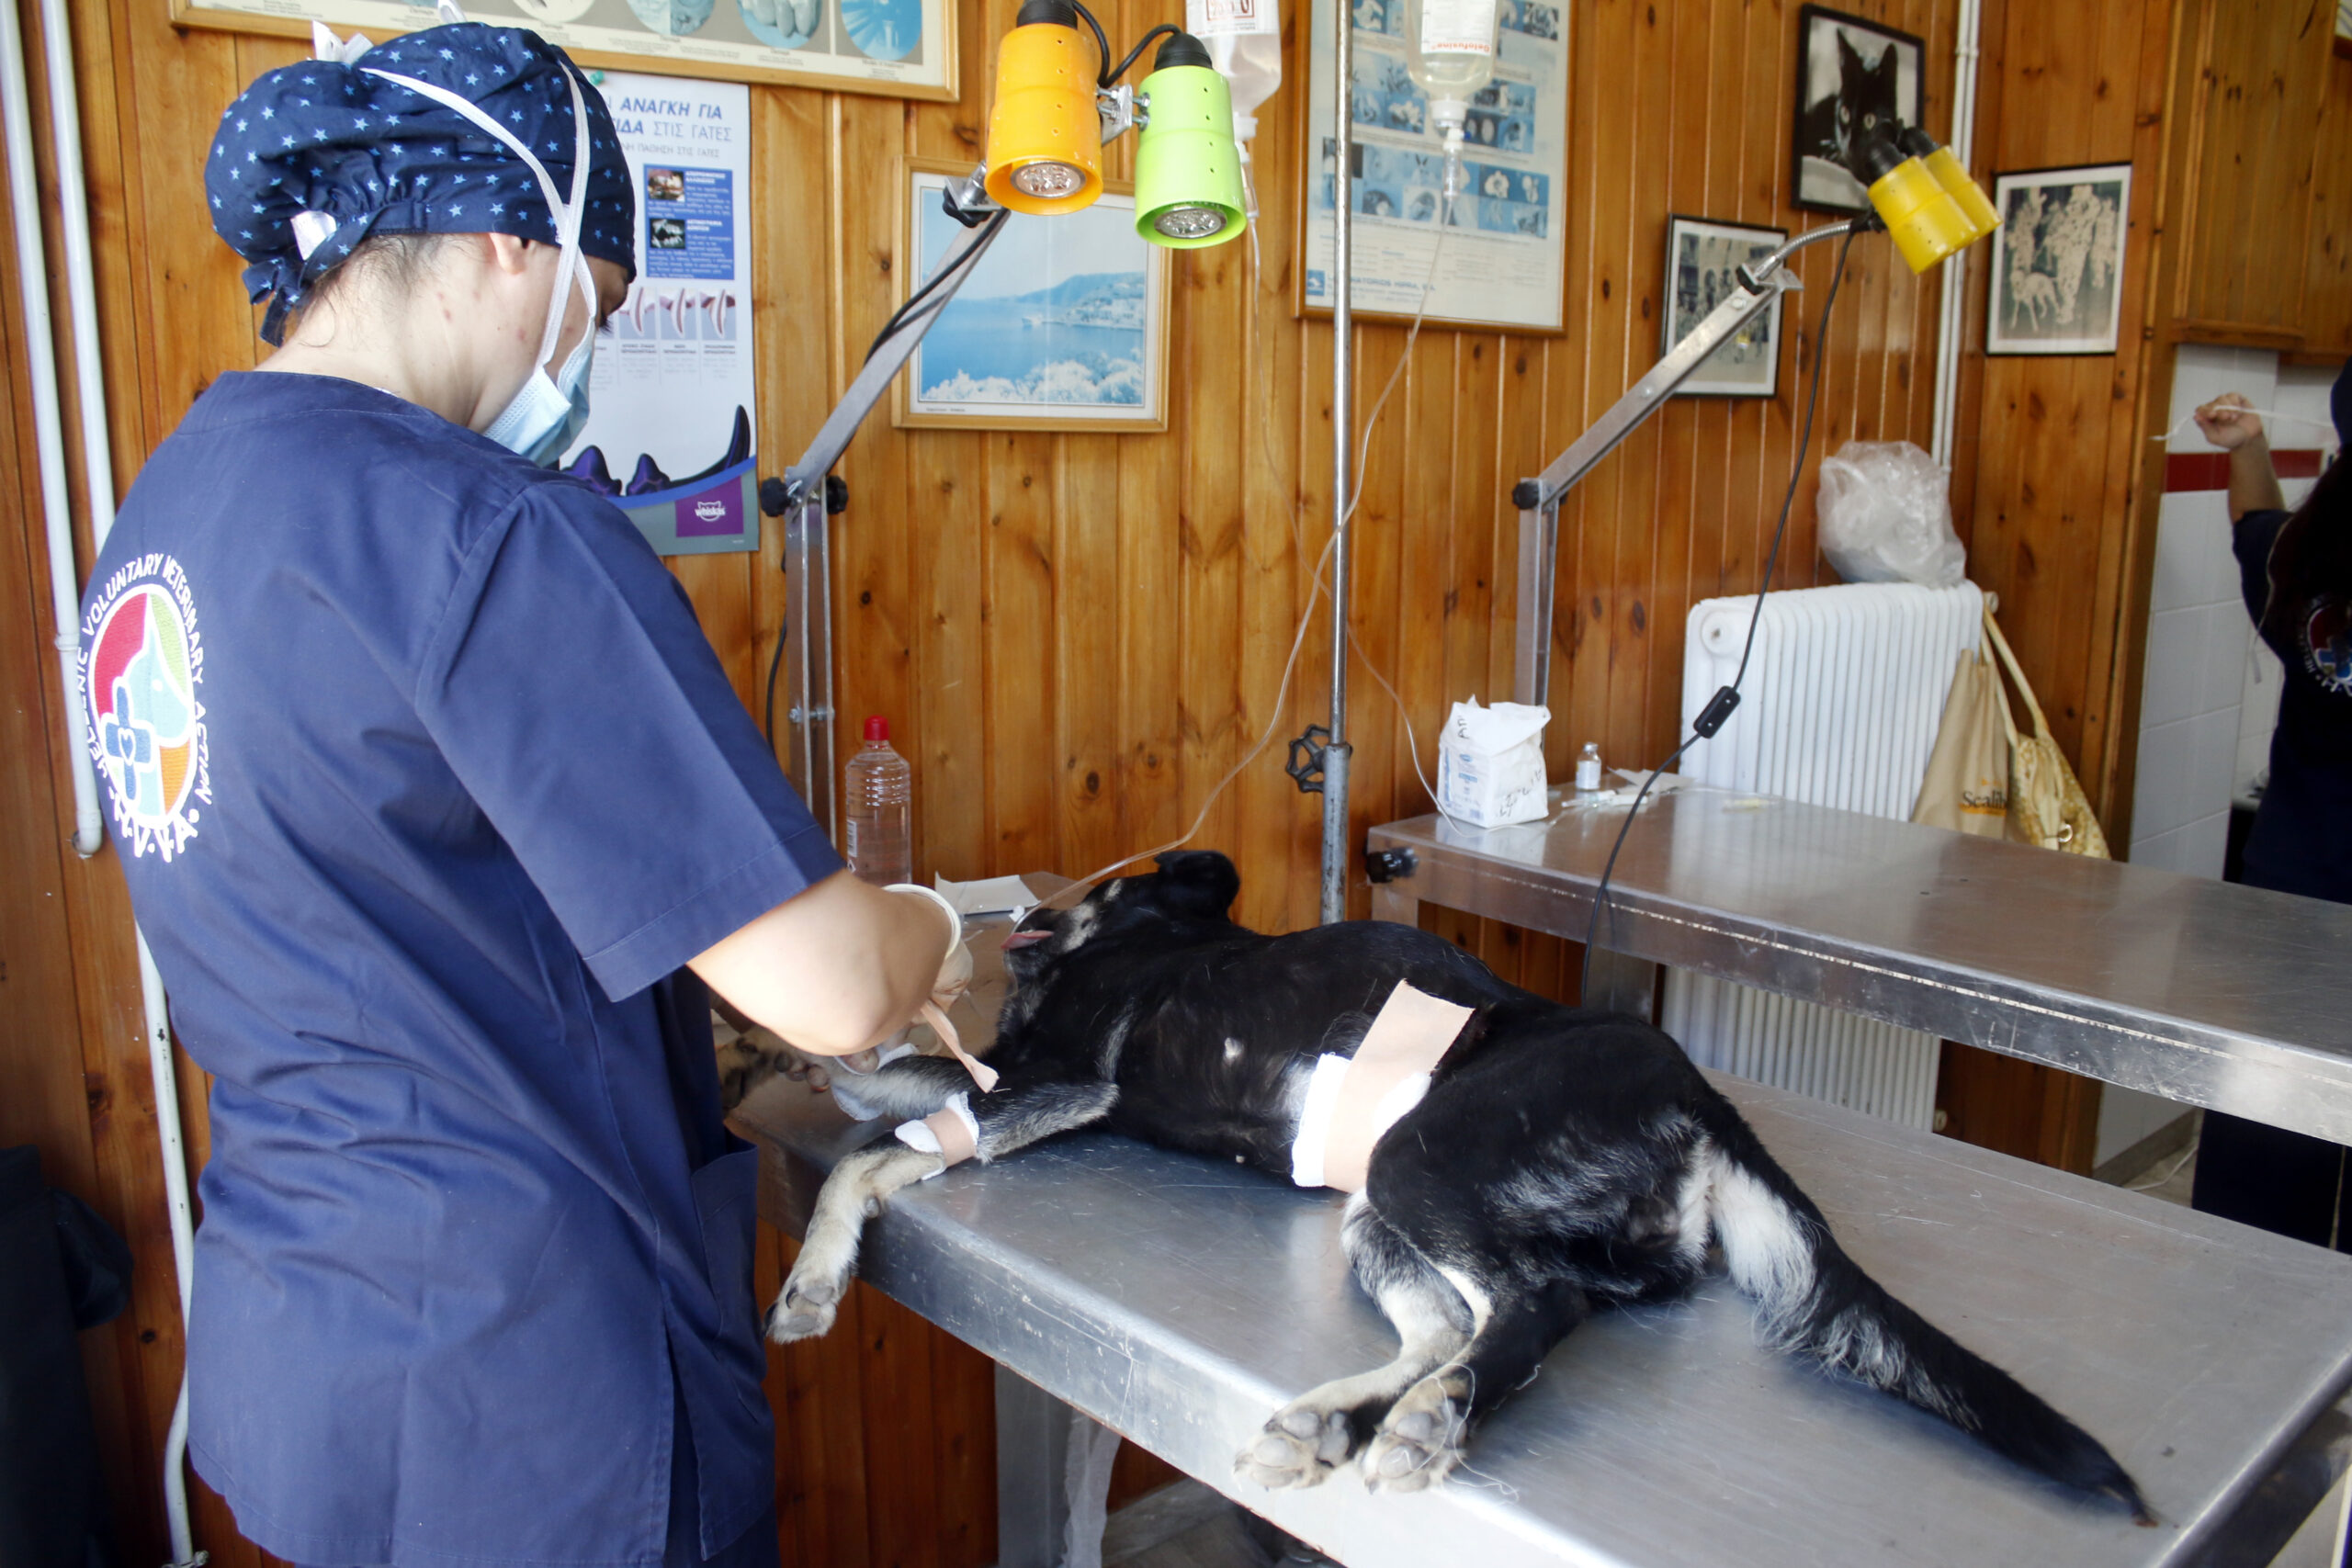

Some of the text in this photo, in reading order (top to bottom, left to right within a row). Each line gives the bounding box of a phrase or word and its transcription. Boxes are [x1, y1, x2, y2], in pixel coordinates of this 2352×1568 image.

[620, 96, 690, 117] ΑΝΑΓΚΗ
[698, 104, 723, 119] ΓΙΑ
[613, 118, 732, 142] ΙΔΑ ΣΤΙΣ ΓΑΤΕΣ
[81, 553, 164, 637] VOLUNTARY
[162, 555, 204, 684] VETERINARY
[194, 701, 213, 806] ACTION
